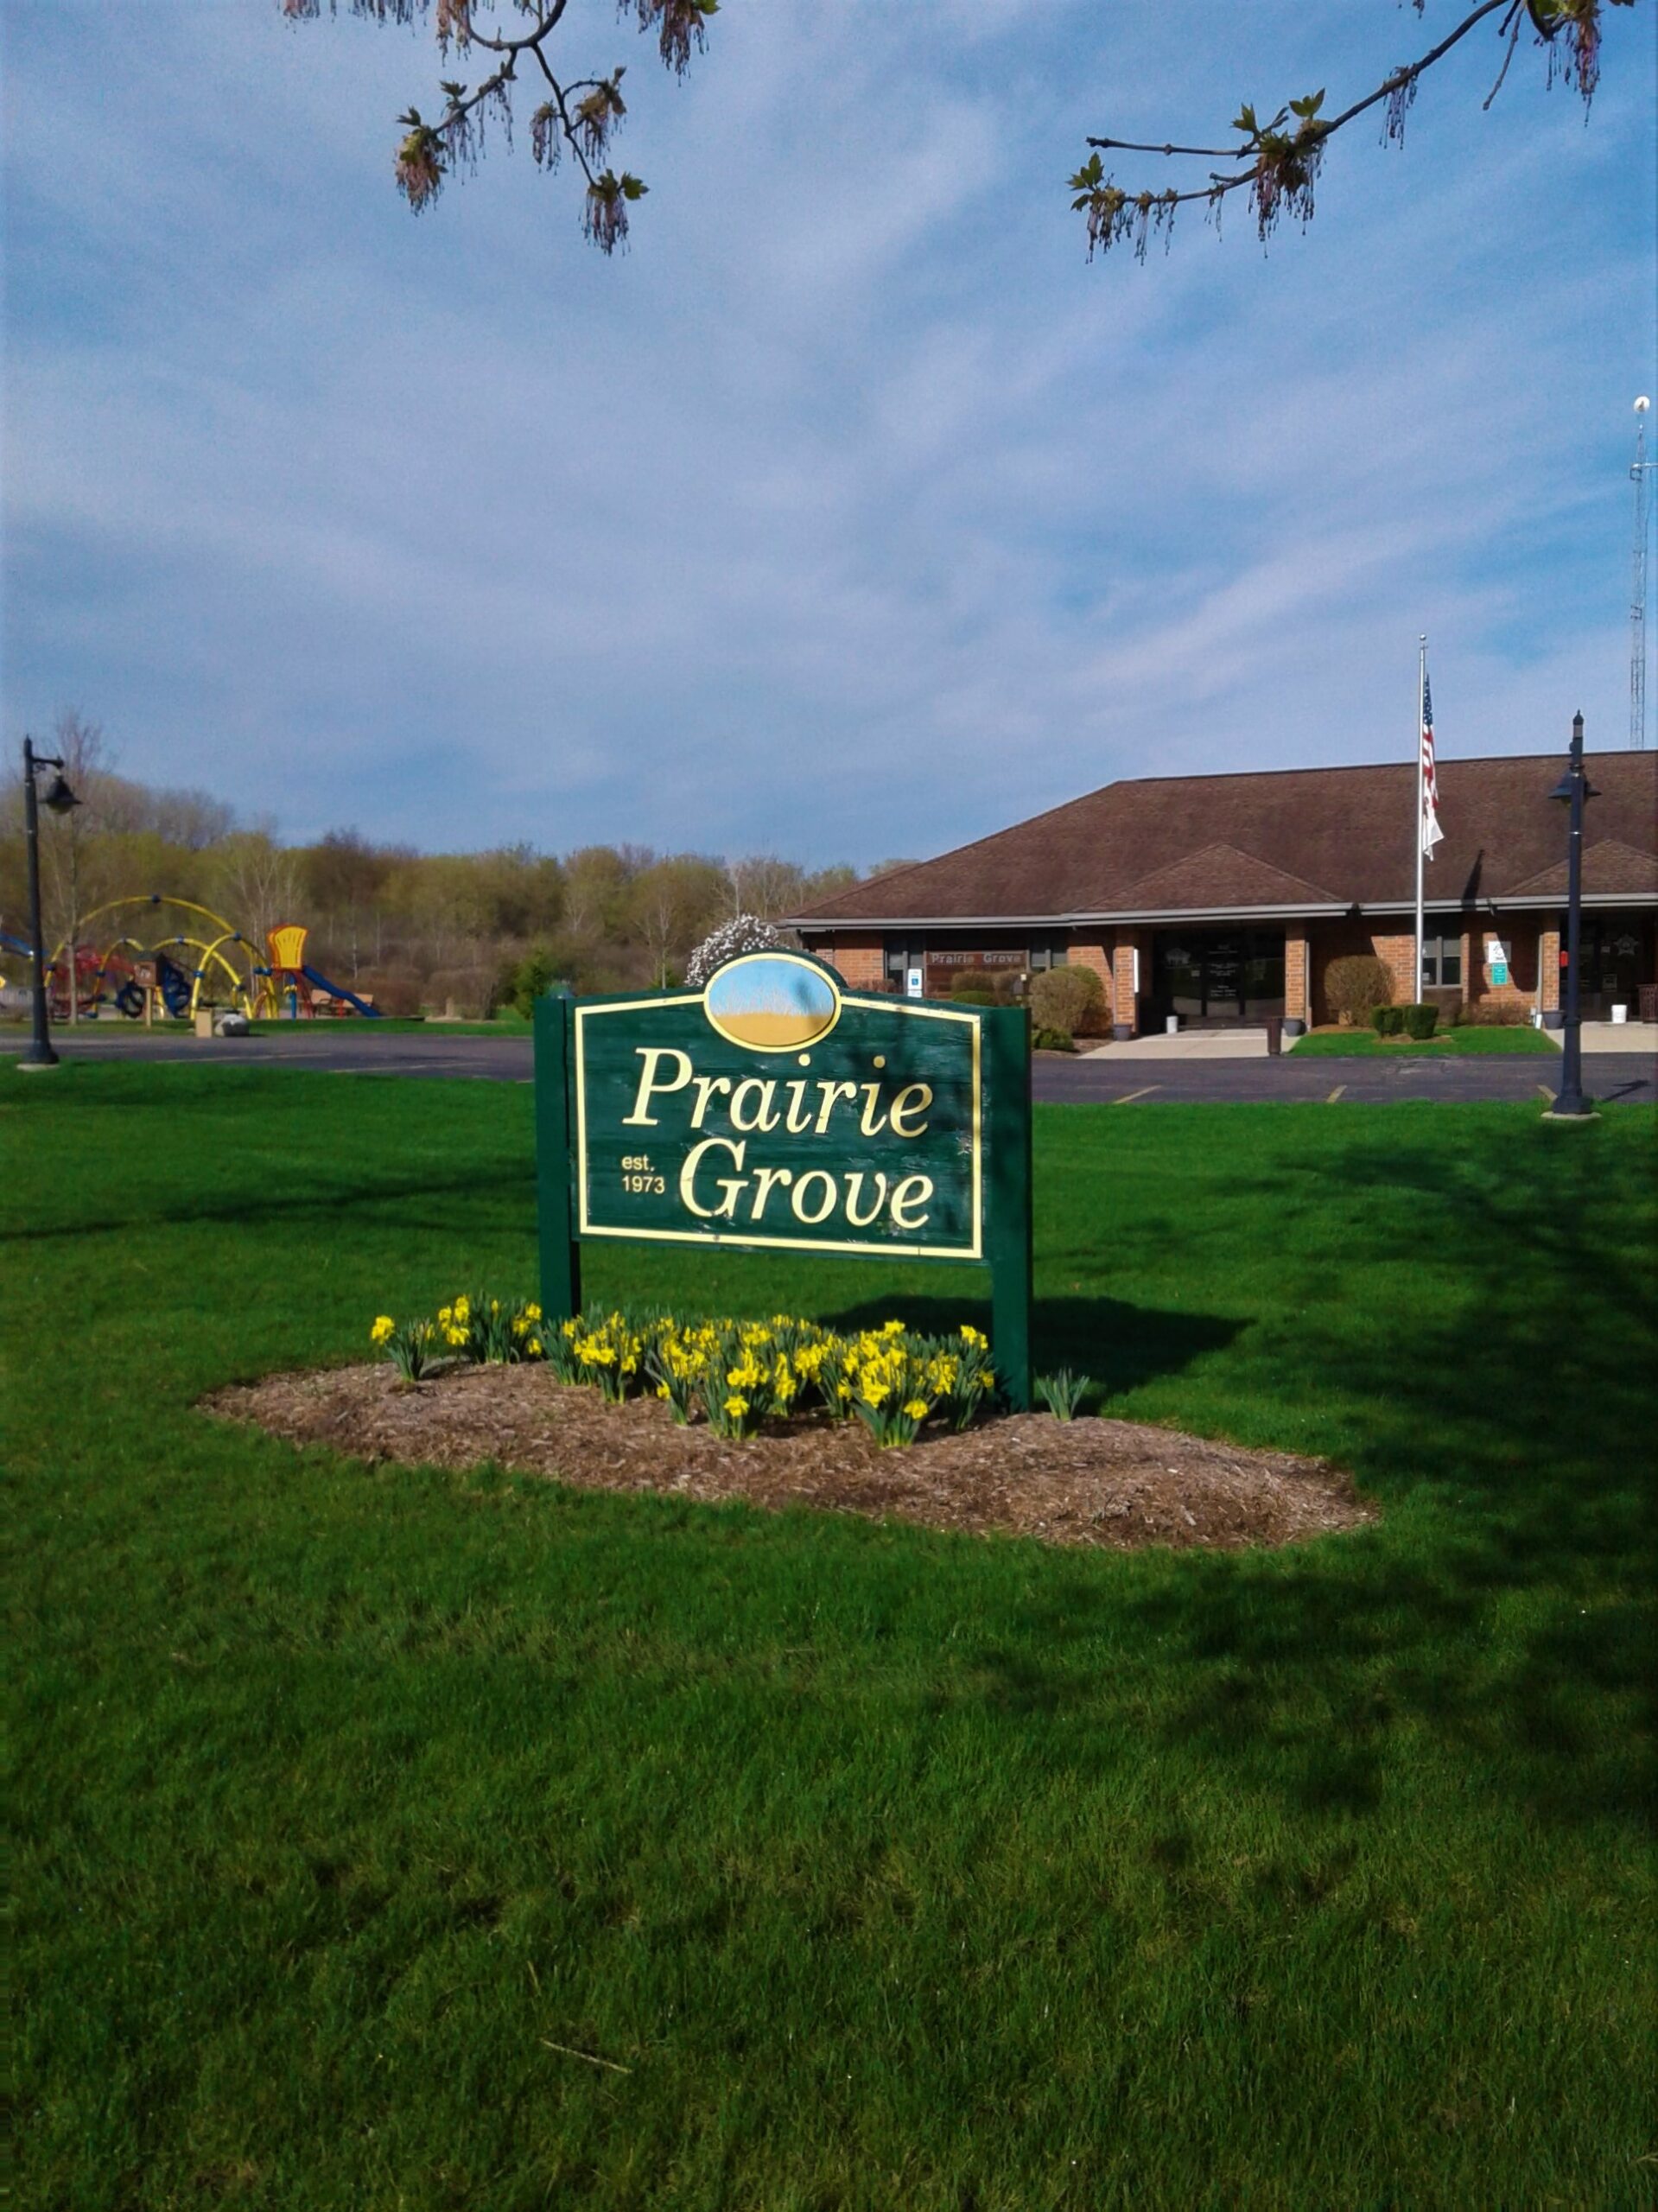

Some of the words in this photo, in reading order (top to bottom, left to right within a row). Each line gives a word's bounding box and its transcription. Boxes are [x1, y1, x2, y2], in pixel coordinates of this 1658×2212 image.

[932, 954, 975, 963] Prairie
[983, 953, 1021, 963] Grove
[622, 1047, 933, 1137] Prairie
[621, 1154, 655, 1173] est.
[621, 1176, 665, 1195] 1973
[680, 1138, 933, 1229] Grove
